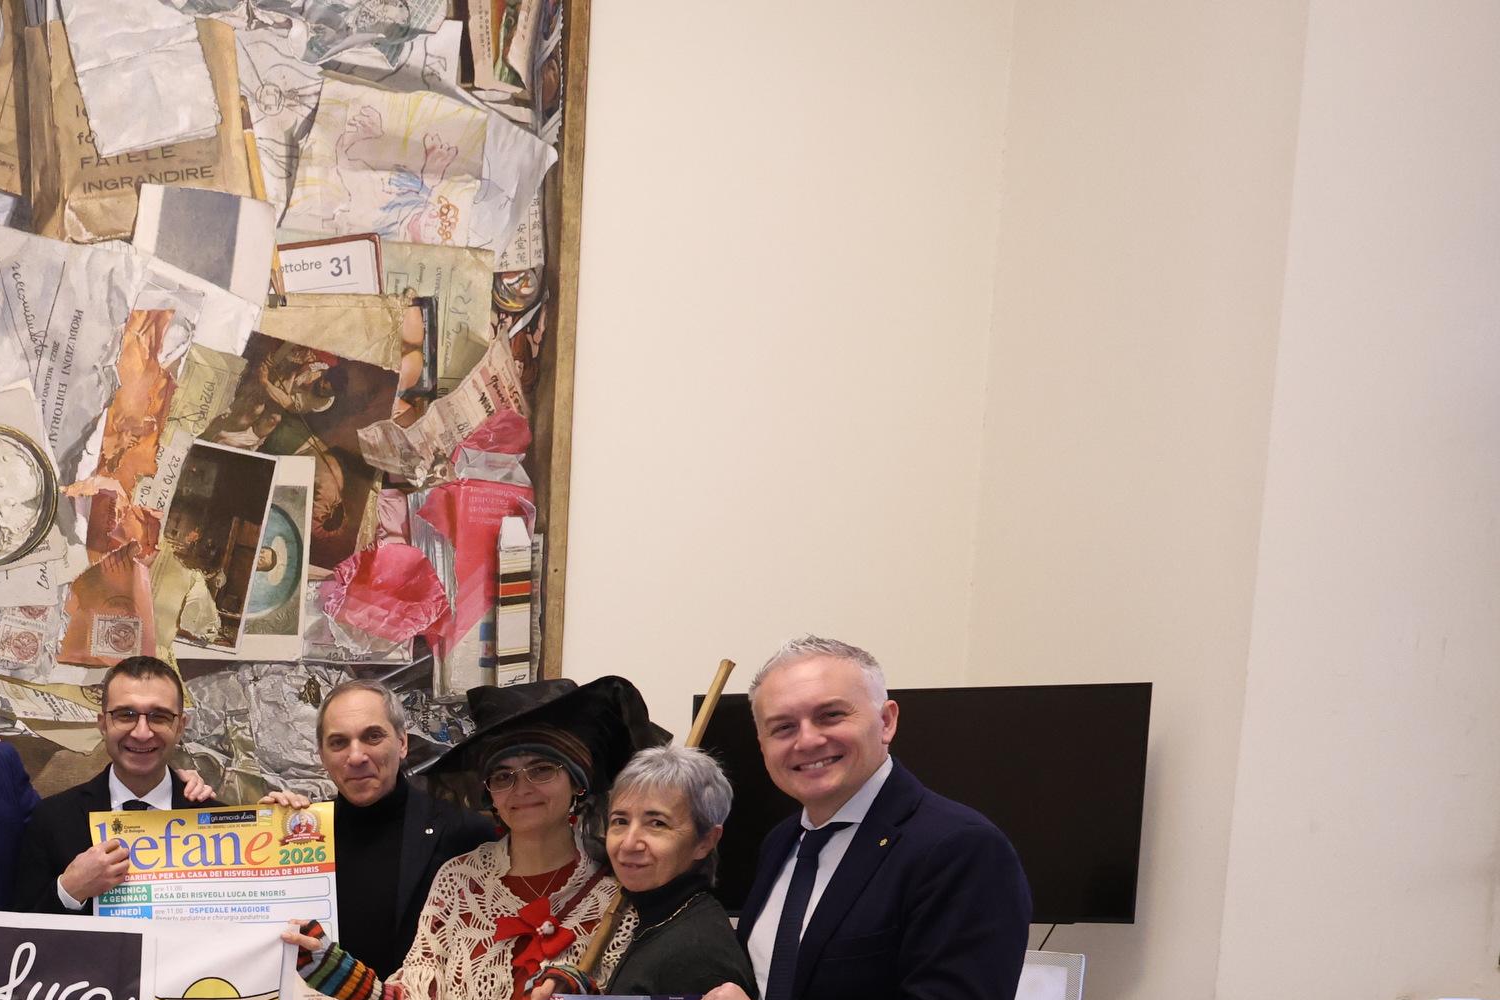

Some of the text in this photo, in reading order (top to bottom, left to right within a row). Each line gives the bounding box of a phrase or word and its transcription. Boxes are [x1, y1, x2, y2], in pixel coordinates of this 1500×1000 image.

[83, 165, 215, 194] INGRANDIRE
[280, 255, 351, 277] ottobre 31
[64, 308, 84, 377] PRODUZIONI
[279, 845, 327, 865] 2026
[159, 865, 320, 880] PER LA CASA DEI RISVEGLI LUCA DE NIGRIS
[109, 895, 148, 904] GENNAIO
[190, 891, 225, 899] RISVEGLI
[260, 889, 287, 897] NIGRIS
[110, 905, 142, 916] LUNEDÌ
[189, 905, 271, 914] OSPEDALE MAGGIORE
